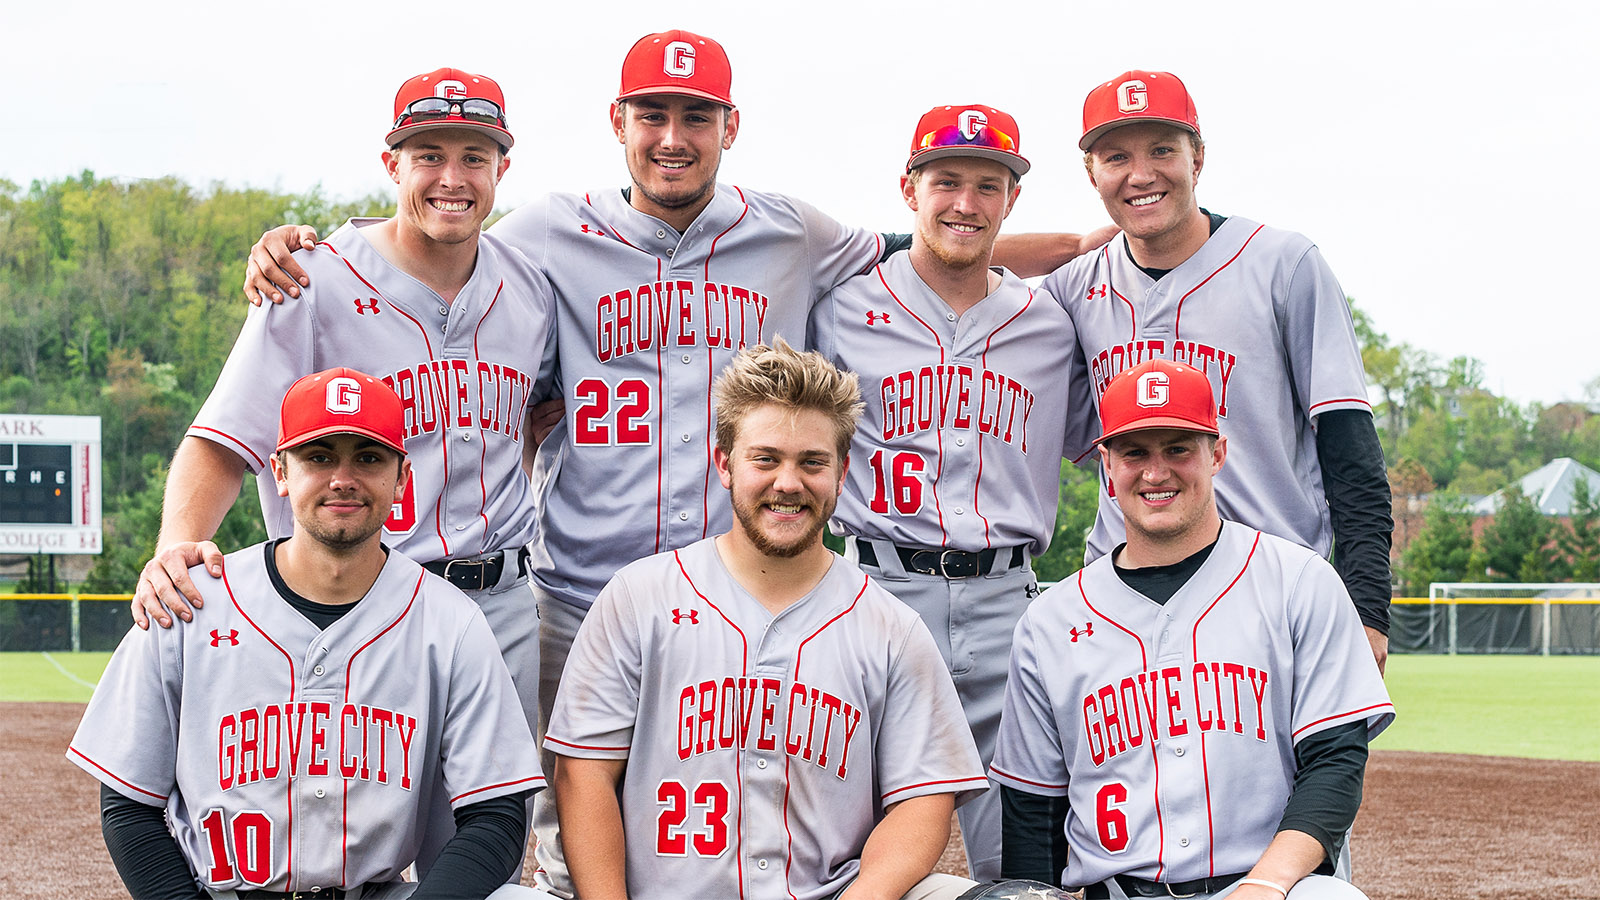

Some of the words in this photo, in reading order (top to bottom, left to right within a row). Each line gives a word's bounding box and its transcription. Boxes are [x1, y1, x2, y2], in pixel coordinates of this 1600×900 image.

[664, 41, 696, 79] G
[1117, 80, 1148, 114] G
[958, 110, 988, 141] G
[596, 280, 696, 363] GROVE
[703, 280, 768, 350] CITY
[326, 377, 361, 415] G
[381, 359, 473, 440] ROVE
[477, 360, 532, 443] CITY
[573, 377, 651, 447] 22
[880, 364, 974, 443] GROVE
[977, 368, 1035, 456] CITY
[1136, 371, 1169, 408] G
[30, 470, 41, 483] H
[55, 470, 66, 484] E
[868, 447, 927, 517] 16
[218, 701, 331, 792] GROVE
[338, 702, 418, 792] CITY
[676, 676, 782, 762] GROVE
[784, 680, 862, 781] CITY
[1082, 666, 1189, 768] GROVE
[1192, 661, 1268, 742] CITY
[199, 807, 274, 888] 10
[656, 779, 730, 859] 23
[1095, 781, 1132, 855] 6
